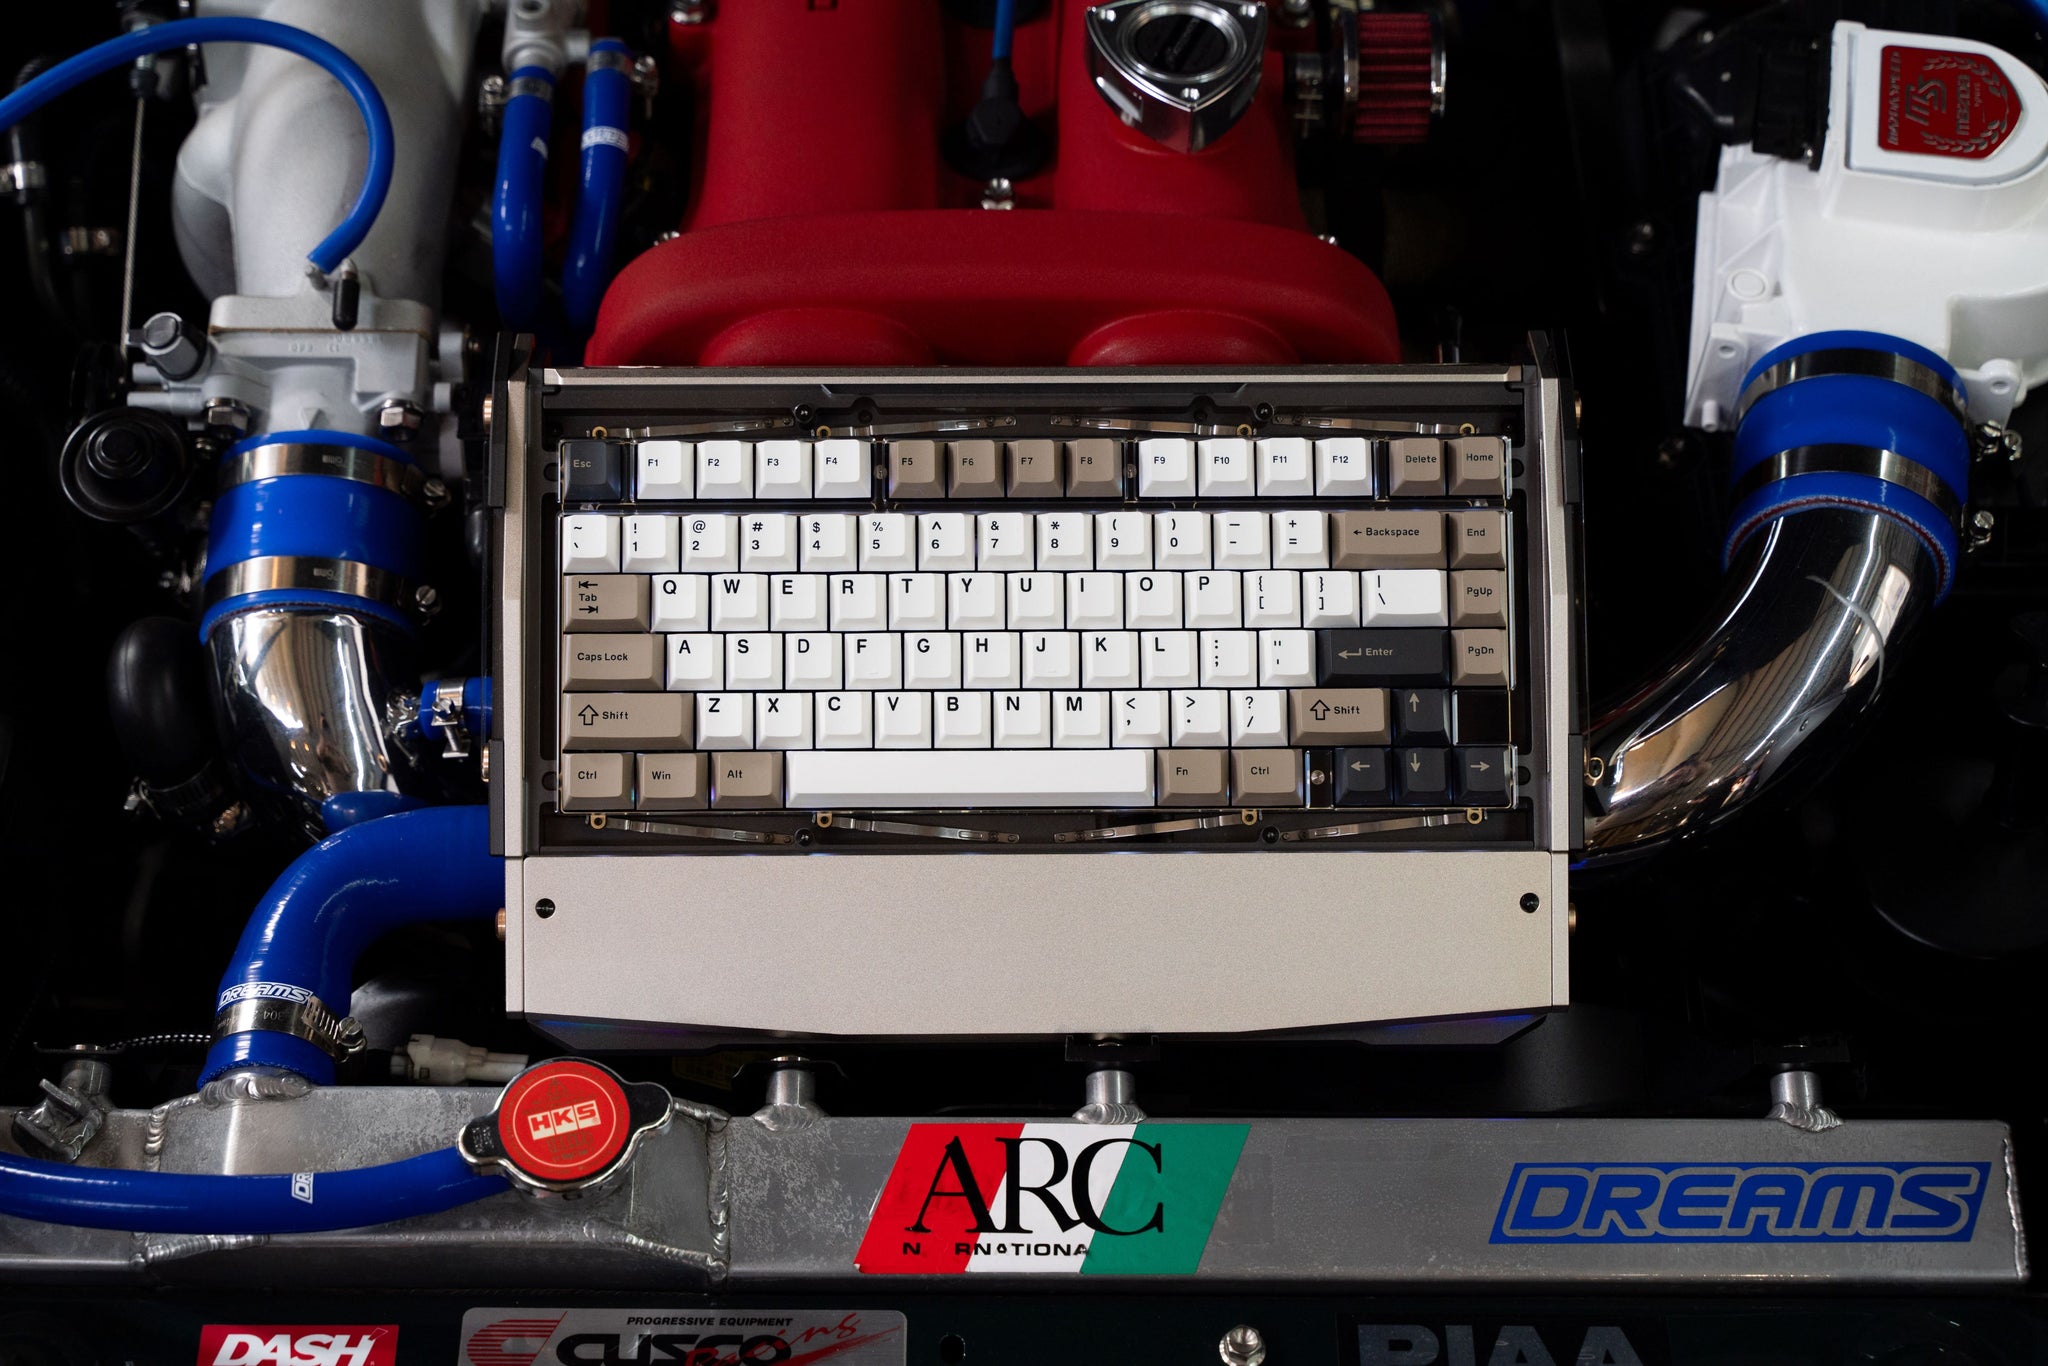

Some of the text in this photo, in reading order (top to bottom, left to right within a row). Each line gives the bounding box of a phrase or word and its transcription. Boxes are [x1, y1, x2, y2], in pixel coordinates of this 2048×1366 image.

[573, 459, 592, 468] Esc
[647, 458, 659, 467] F1
[707, 458, 720, 467] F2
[767, 458, 780, 467] F3
[825, 456, 838, 465] F4
[901, 457, 913, 466] F5
[962, 457, 974, 467] F6
[1020, 456, 1034, 465] F7
[1080, 456, 1093, 465] F8
[1153, 456, 1166, 465] F9
[1213, 456, 1230, 465] F10
[1272, 455, 1287, 464] F11
[1332, 455, 1349, 464] F12
[1405, 455, 1437, 464] Delete
[1466, 453, 1494, 462] Home
[633, 522, 637, 534] !
[692, 519, 706, 534] @
[751, 521, 764, 532] #
[812, 521, 821, 534] $
[872, 521, 884, 532] %
[990, 520, 1000, 531] &
[1112, 518, 1117, 531] (
[1171, 518, 1177, 531] )
[1288, 519, 1297, 528] +
[1365, 527, 1420, 538] Backspace
[1466, 528, 1486, 537] End
[632, 541, 638, 552] 1
[692, 540, 700, 551] 2
[751, 539, 760, 551] 3
[812, 539, 821, 551] 4
[872, 539, 881, 550] 5
[931, 538, 940, 550] 6
[990, 538, 999, 549] 7
[1050, 538, 1059, 549] 8
[1110, 537, 1119, 548] 9
[1169, 537, 1179, 548] 0
[662, 579, 677, 595] Q
[723, 578, 741, 594] W
[782, 579, 794, 595] E
[842, 579, 854, 595] R
[901, 578, 913, 594] T
[961, 577, 973, 593] Y
[1020, 577, 1032, 593] U
[1139, 576, 1154, 592] O
[1198, 575, 1210, 591] P
[1258, 575, 1263, 592] {
[1319, 576, 1324, 593] }
[578, 593, 598, 602] Tab
[1466, 586, 1493, 598] PgUp
[1258, 595, 1265, 610] [
[1318, 596, 1325, 611] ]
[678, 639, 691, 655] A
[737, 638, 750, 654] S
[797, 638, 810, 654] D
[856, 638, 868, 654] F
[916, 637, 931, 654] G
[975, 637, 989, 653] H
[1035, 637, 1046, 653] J
[1095, 636, 1108, 652] K
[1154, 636, 1166, 652] L
[577, 652, 628, 663] Caps Lock
[1365, 647, 1393, 656] Enter
[1467, 646, 1494, 657] PgDn
[708, 697, 721, 713] Z
[767, 697, 779, 713] X
[827, 696, 841, 712] C
[887, 696, 900, 712] V
[946, 696, 960, 712] B
[1006, 695, 1020, 711] N
[1066, 695, 1083, 712] M
[1125, 697, 1136, 710] <
[1185, 696, 1196, 708] >
[1245, 695, 1254, 710] ?
[602, 710, 629, 720] Shift
[1333, 705, 1360, 715] Shift
[577, 770, 597, 780] Ctrl
[651, 770, 671, 781] Win
[726, 769, 743, 779] Alt
[1176, 766, 1189, 776] Fn
[1250, 766, 1270, 776] Ctrl
[218, 982, 312, 1007] DREAMS
[528, 1101, 599, 1135] HKS
[905, 1136, 1163, 1236] ARC
[1505, 1168, 1978, 1235] DREAMS
[627, 1316, 794, 1327] PROGRESSIVE EQUIPMENT
[212, 1334, 376, 1366] DASH
